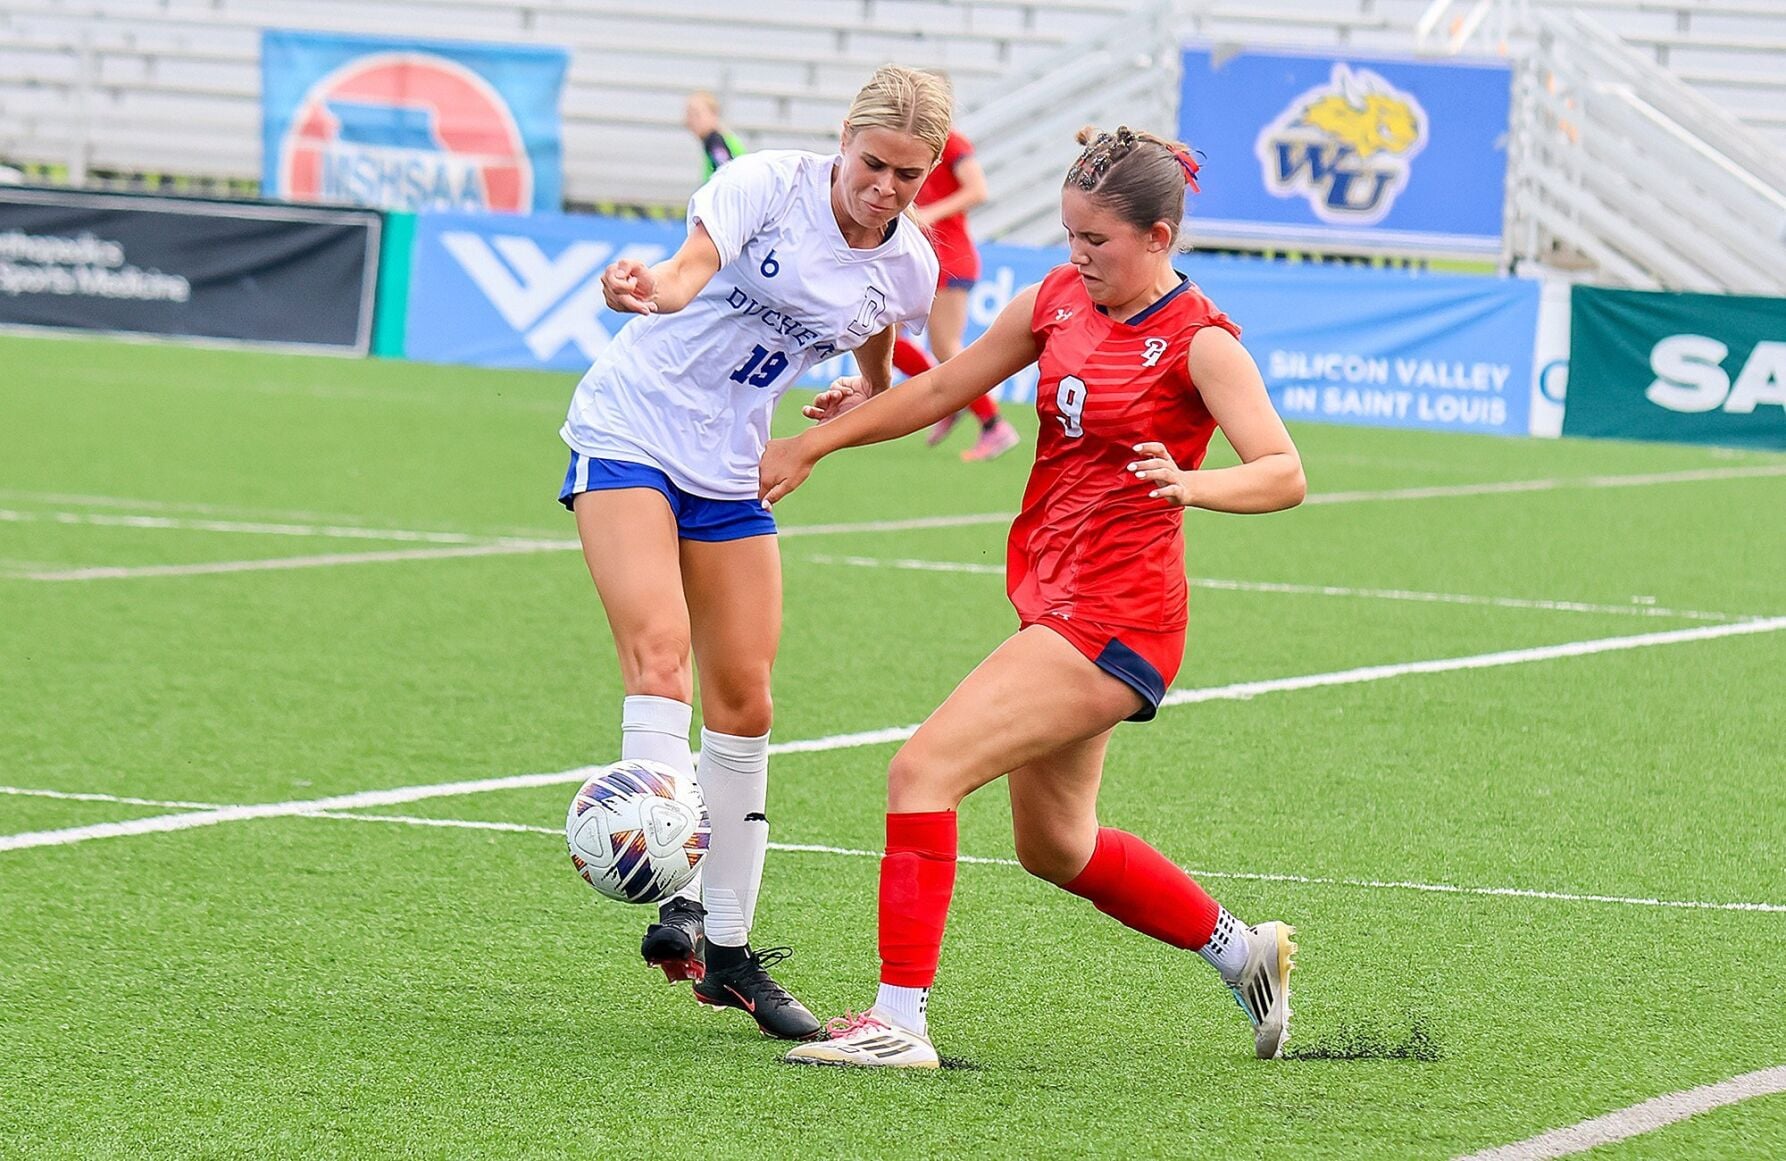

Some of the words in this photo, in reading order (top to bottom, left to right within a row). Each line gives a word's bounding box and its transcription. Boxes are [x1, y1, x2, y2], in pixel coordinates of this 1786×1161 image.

[323, 153, 482, 208] MSHSAA
[1271, 139, 1395, 211] WU
[760, 249, 780, 278] 6
[729, 344, 789, 388] 19
[1270, 350, 1389, 384] SILICON
[1395, 359, 1509, 391] VALLEY
[1056, 374, 1088, 438] 9
[1283, 387, 1317, 411] IN
[1322, 387, 1411, 418] SAINT
[1417, 393, 1507, 425] LOUIS
